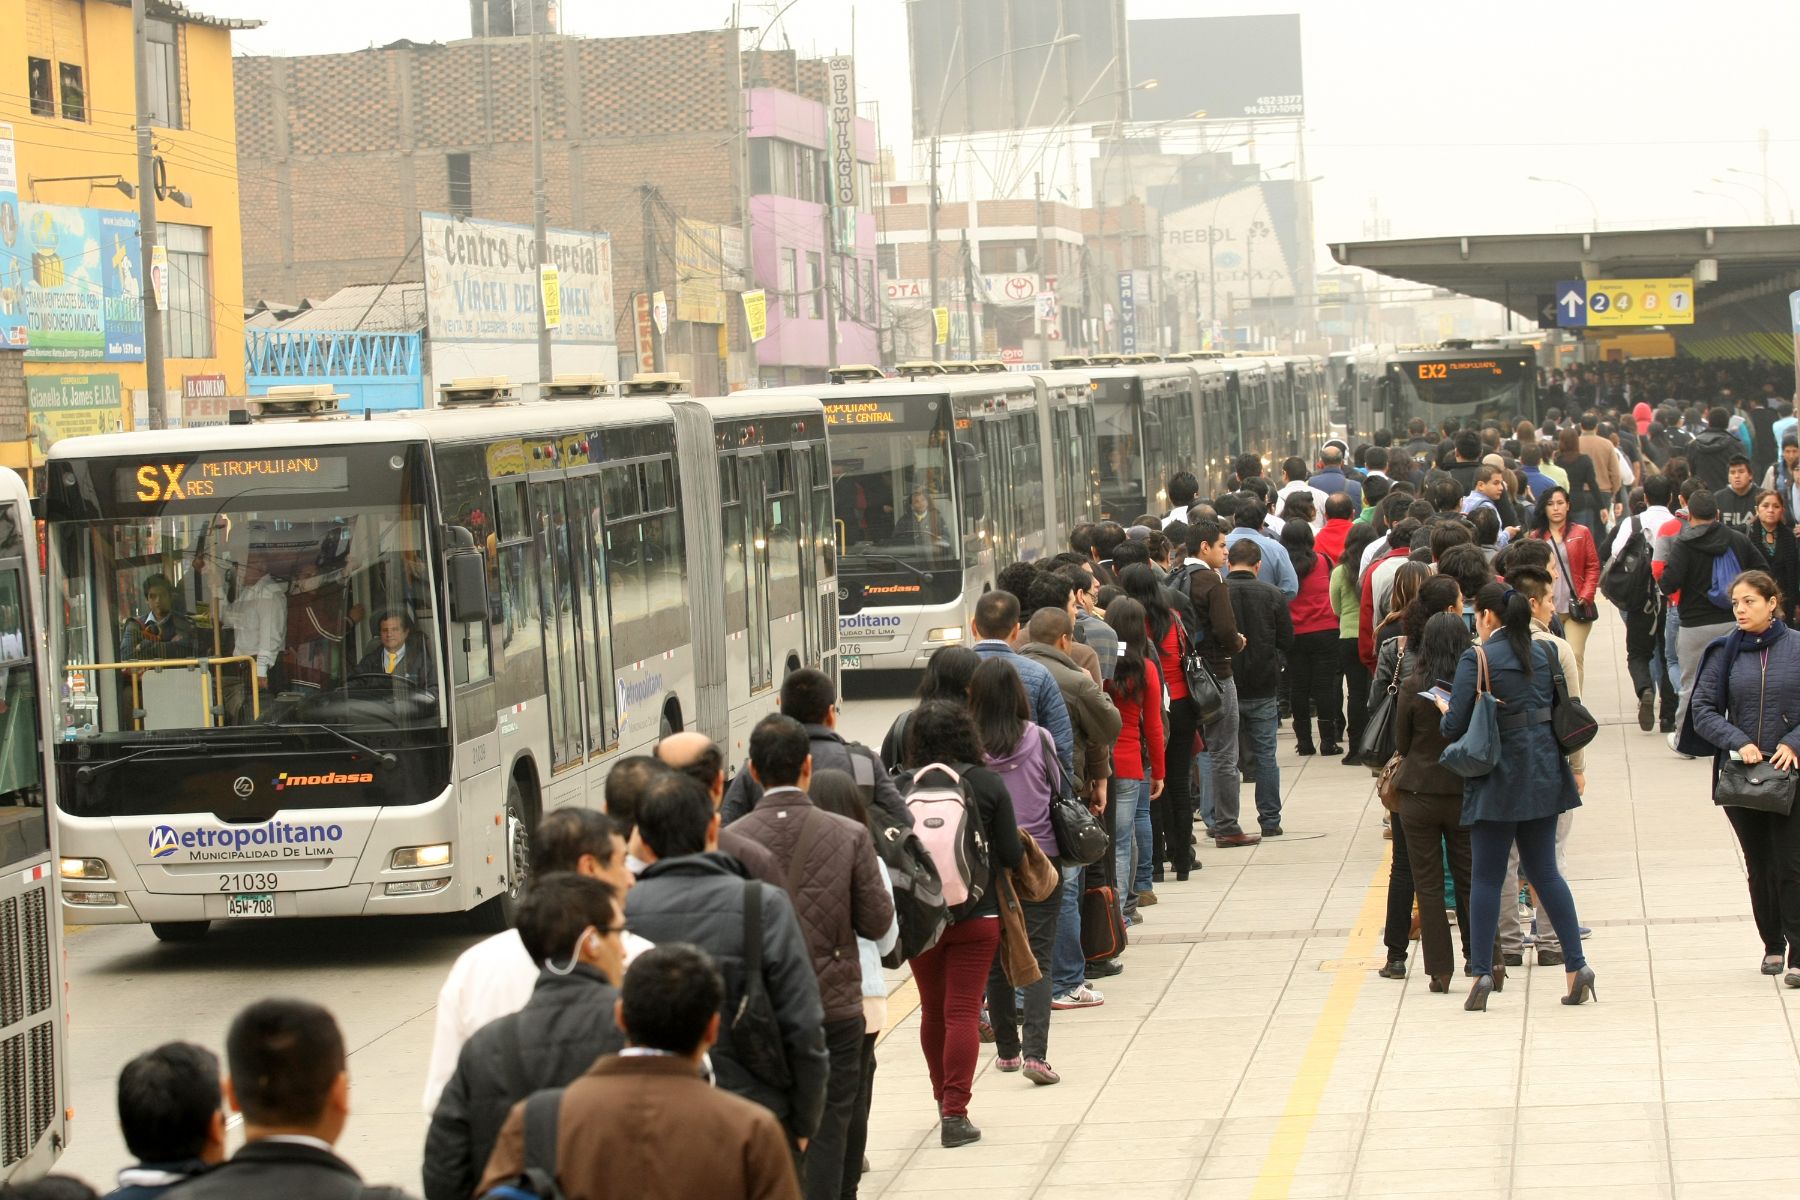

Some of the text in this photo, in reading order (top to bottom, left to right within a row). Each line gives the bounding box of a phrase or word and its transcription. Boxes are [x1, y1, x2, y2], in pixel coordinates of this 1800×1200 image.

[834, 75, 853, 203] EL MILAGRO
[444, 225, 509, 268] Centro
[1593, 296, 1605, 310] 2
[1616, 295, 1628, 310] 4
[1674, 294, 1683, 308] 1
[41, 312, 73, 332] MISIONERO
[74, 313, 100, 332] MUNDIAL
[1418, 363, 1447, 379] EX2
[62, 386, 69, 407] &
[70, 386, 94, 407] James
[855, 411, 894, 423] CENTRAL
[136, 457, 320, 502] SX METROPOLITANO
[187, 480, 214, 496] RES
[1723, 511, 1754, 526] FILA
[869, 584, 920, 594] modasa
[285, 772, 374, 787] modasa
[149, 821, 343, 859] Metropolitano
[219, 873, 278, 892] 21039
[229, 899, 273, 914] A5W-708
